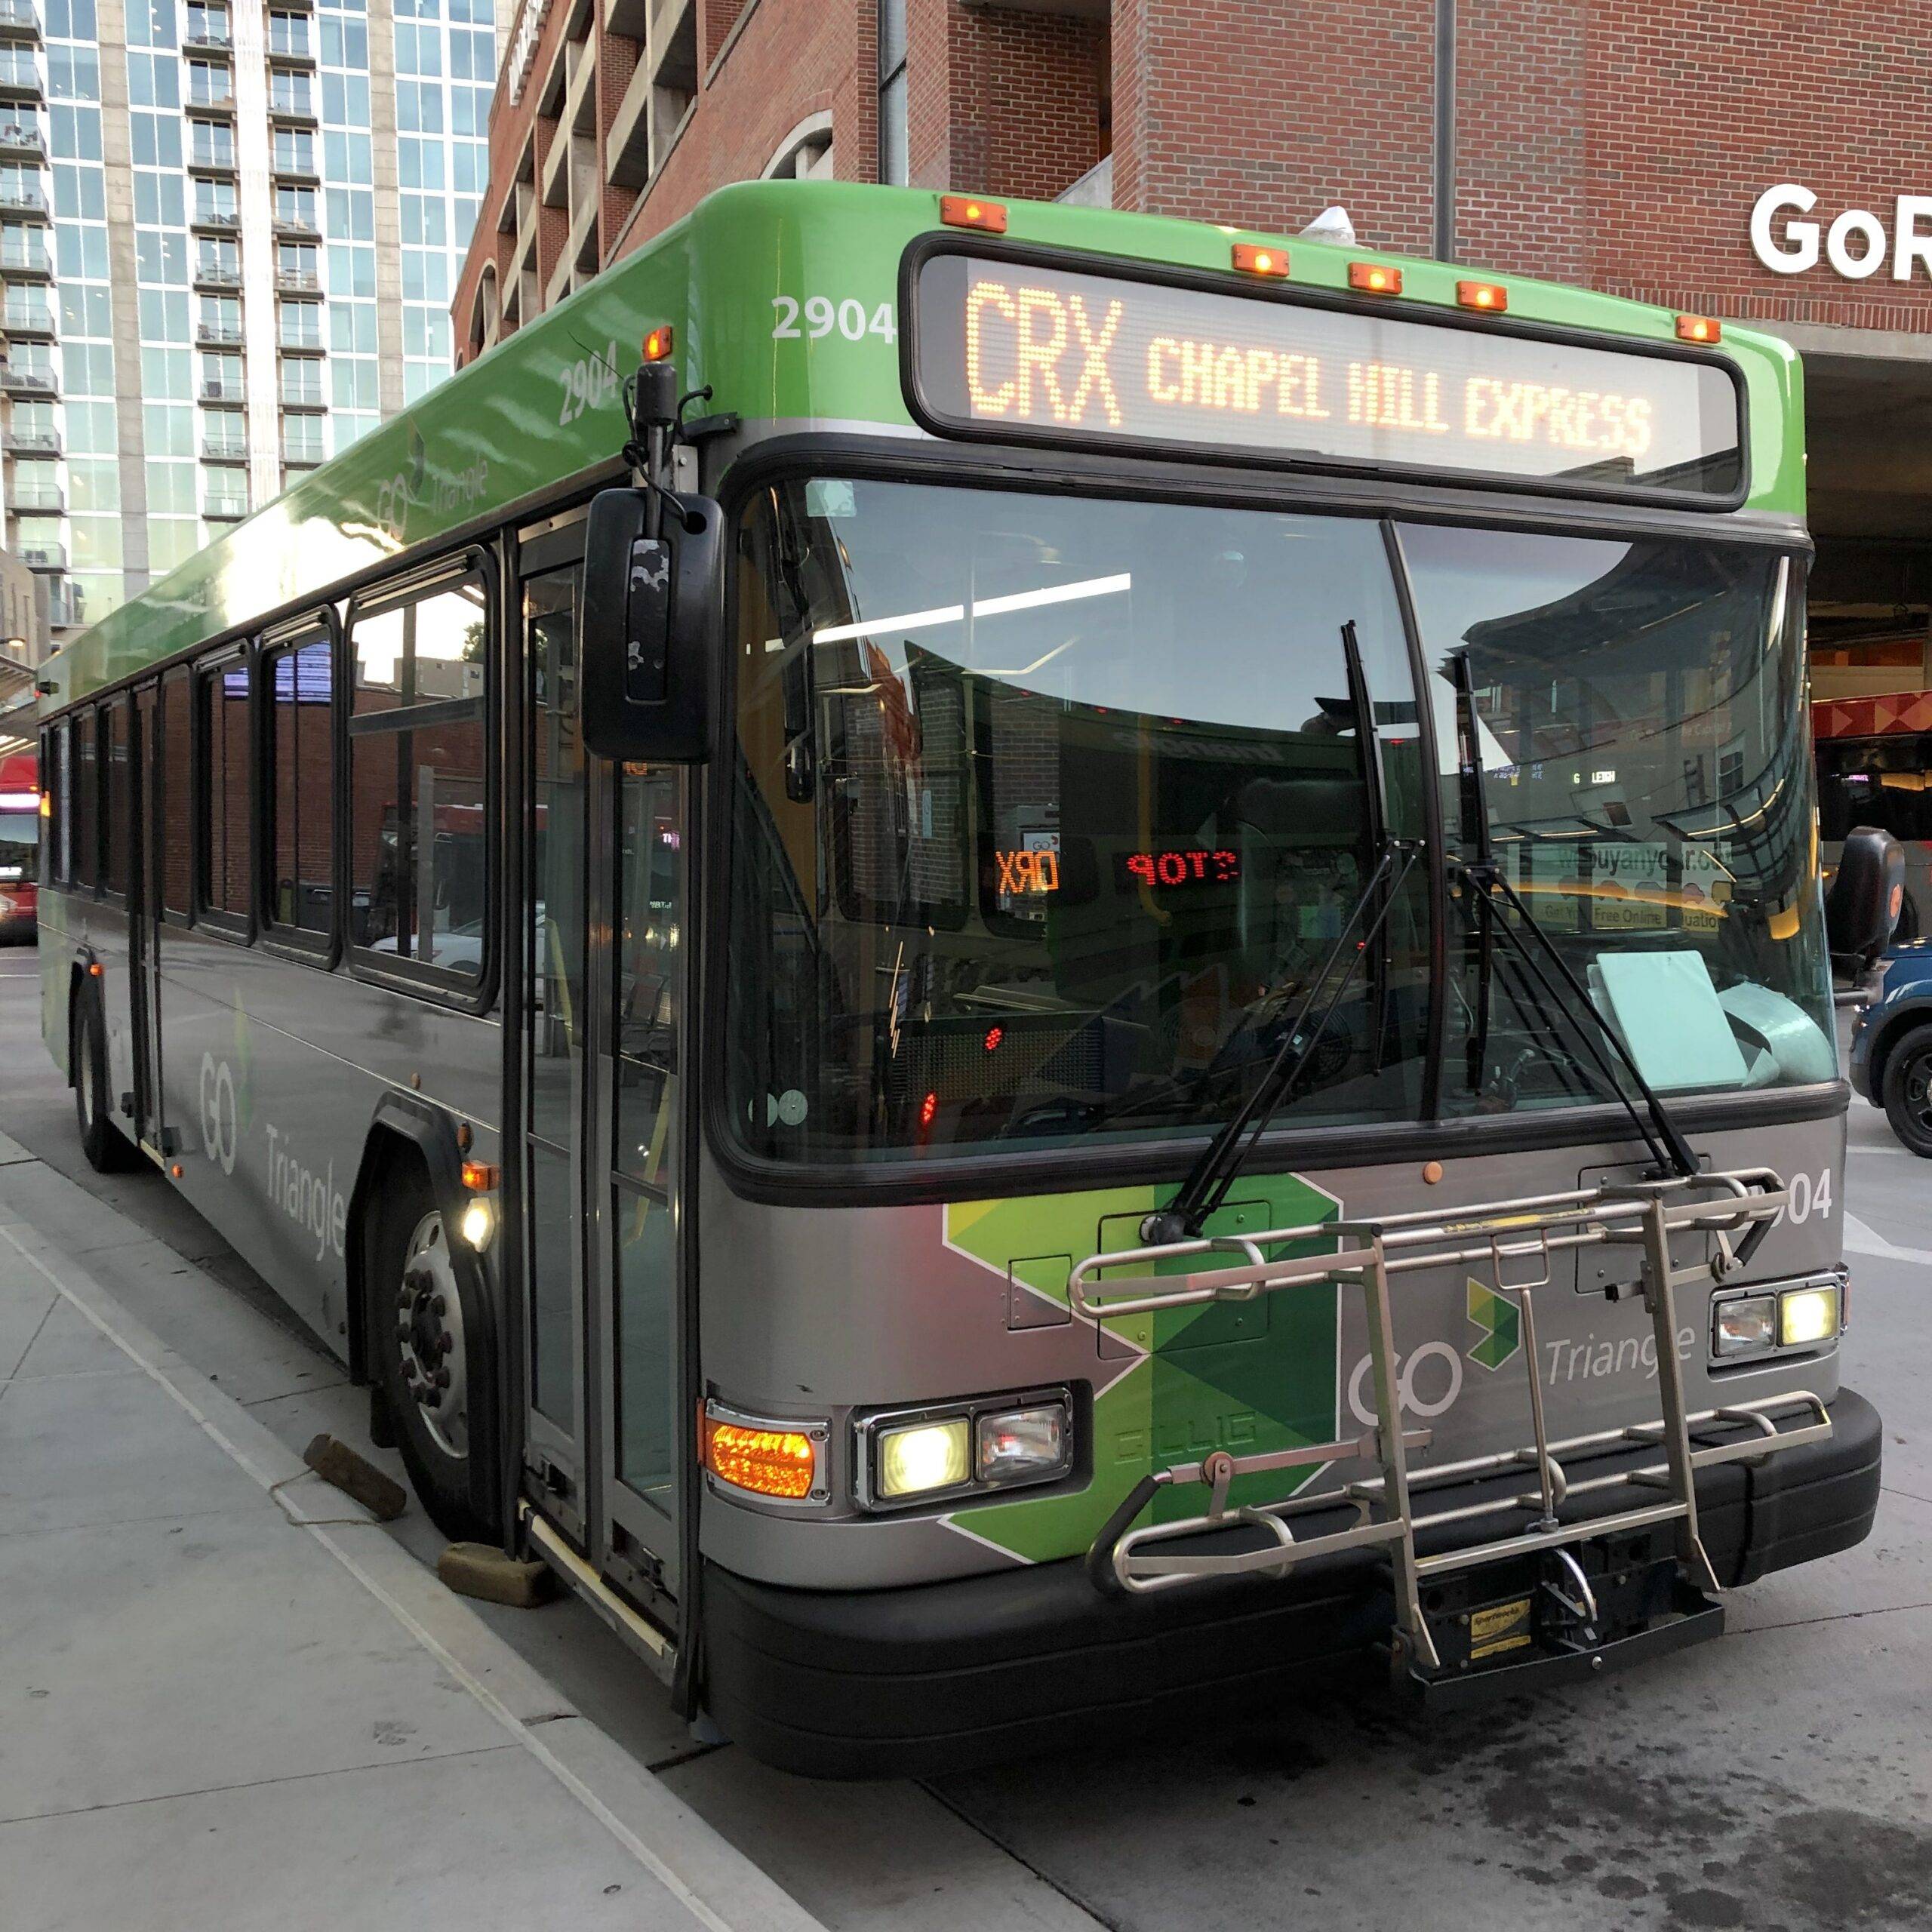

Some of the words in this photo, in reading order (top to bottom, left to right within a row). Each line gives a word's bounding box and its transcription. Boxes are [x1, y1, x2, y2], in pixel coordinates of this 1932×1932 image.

[771, 295, 897, 344] 2904
[558, 340, 617, 426] 2904
[967, 281, 1121, 428] CRX
[1147, 337, 1329, 417] CHAPEL
[1348, 361, 1449, 432] HILL
[1465, 377, 1653, 454] EXPRESS
[1595, 907, 1619, 921] Free
[1623, 910, 1661, 924] Online
[200, 1051, 236, 1176] GO
[266, 1123, 346, 1263] Triangle
[1734, 1168, 1832, 1231] 04
[1348, 1341, 1463, 1426] GO
[1546, 1327, 1696, 1386] Triange
